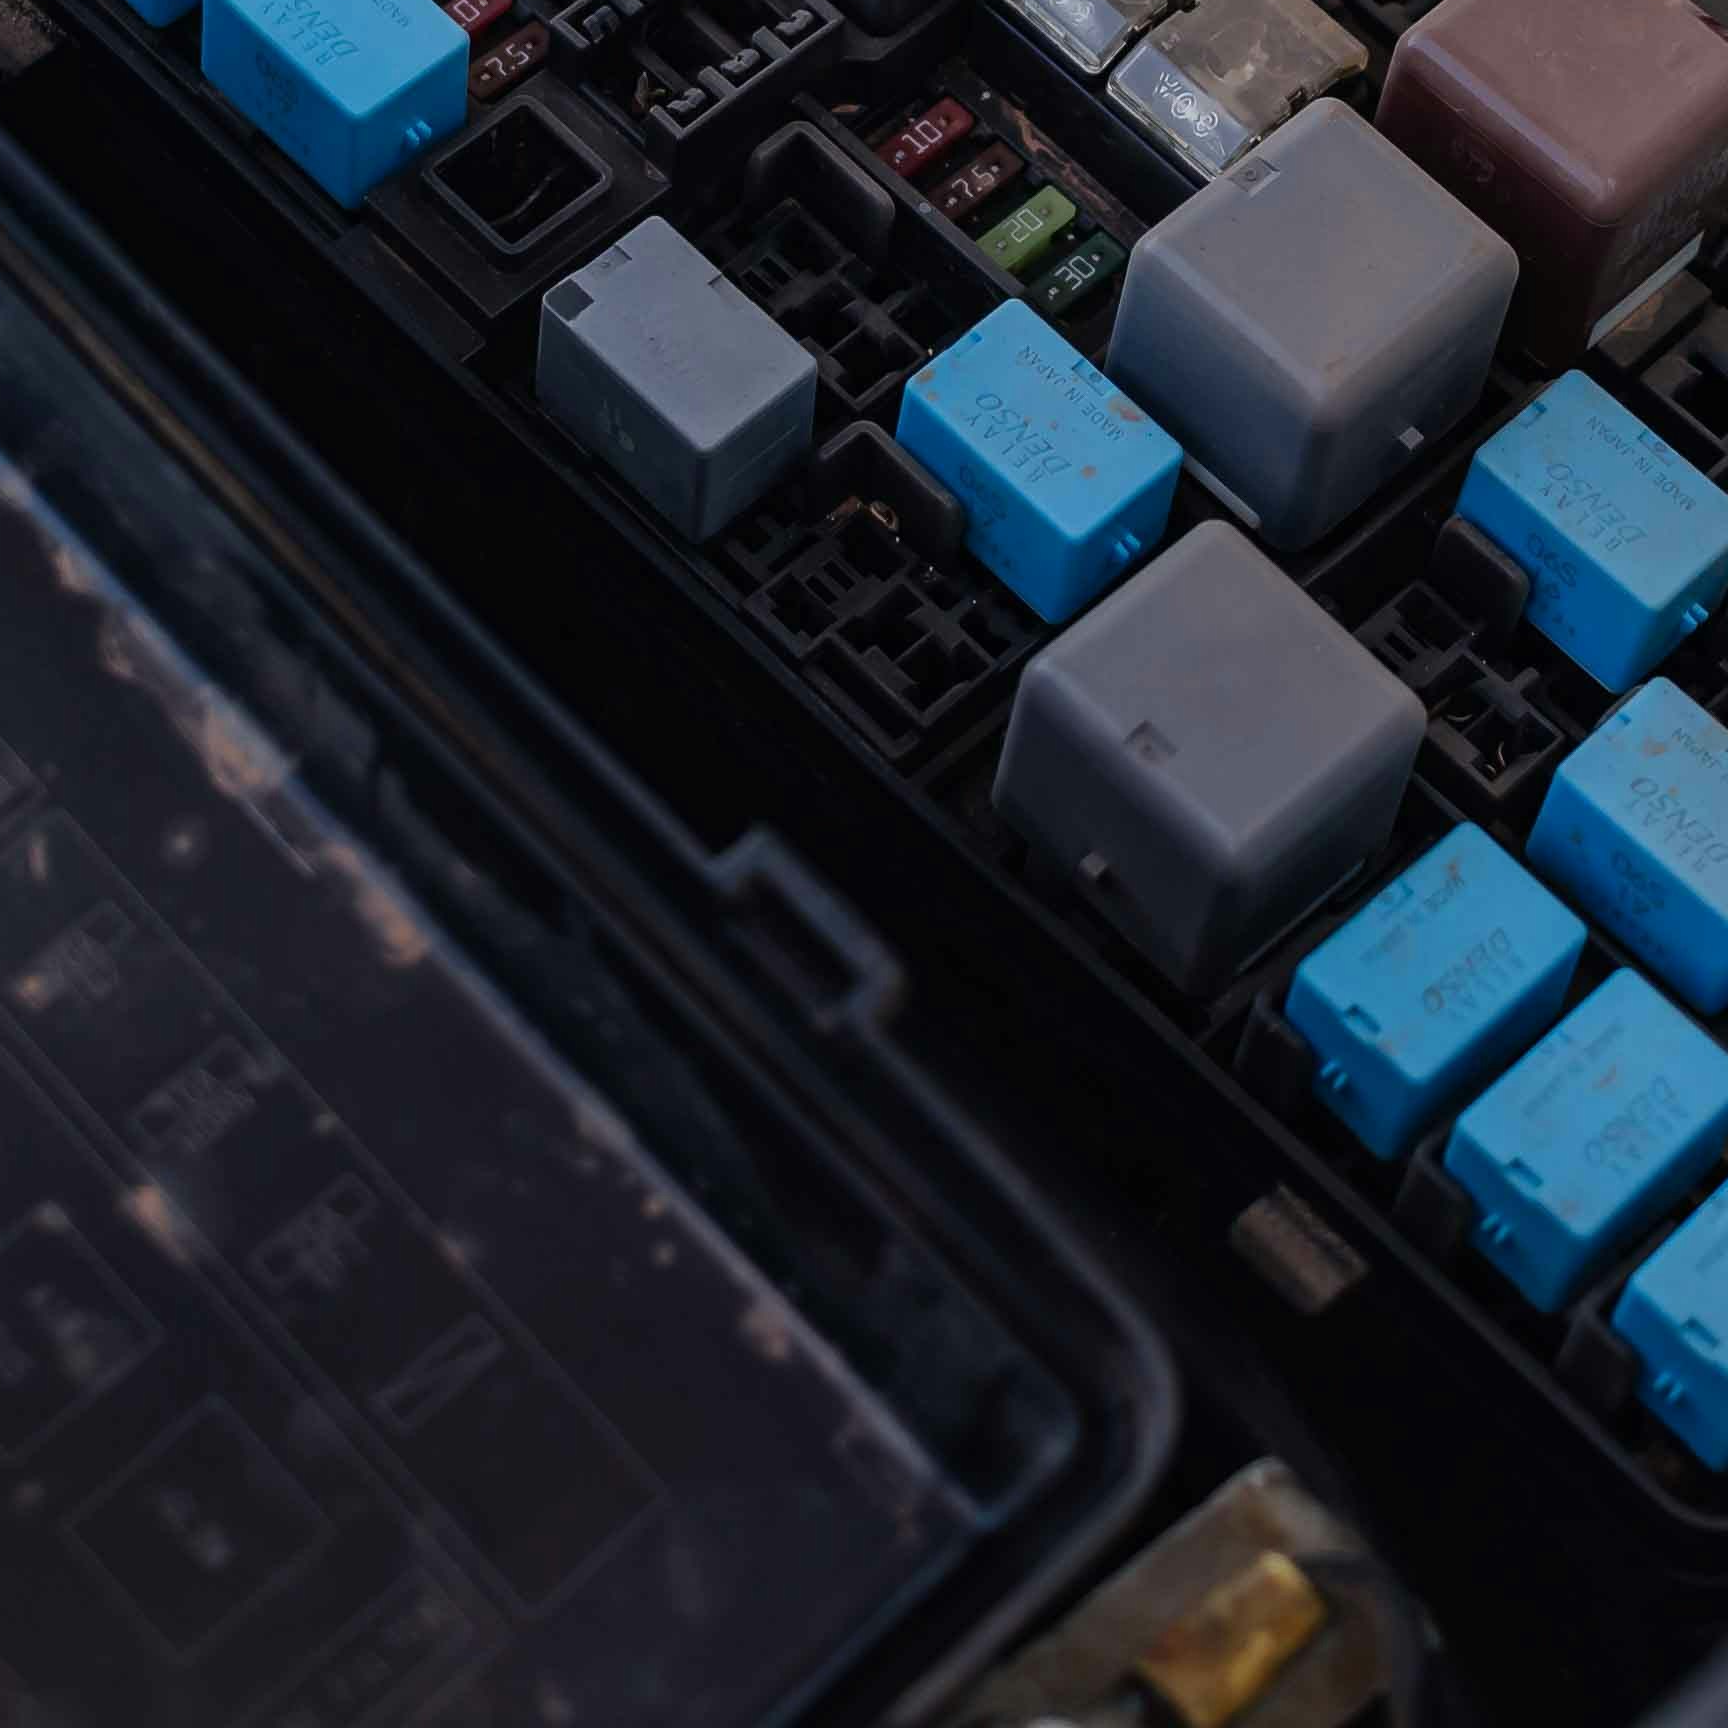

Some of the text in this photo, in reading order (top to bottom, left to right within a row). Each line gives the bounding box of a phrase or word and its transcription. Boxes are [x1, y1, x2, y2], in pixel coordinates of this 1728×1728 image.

[264, 1, 335, 65] RELAY
[484, 43, 529, 76] 7.5
[902, 120, 943, 154] 10
[951, 165, 995, 198] 7.5
[1003, 208, 1043, 243] 20
[1054, 255, 1096, 291] 30
[1018, 345, 1067, 385] JAPAN
[976, 393, 1072, 474] DENSO
[1081, 404, 1125, 441] MADE
[1587, 416, 1633, 456] JAPAN
[964, 414, 1045, 483] RELAY
[1546, 463, 1648, 545] DENSO
[1653, 475, 1697, 512] MADE
[1540, 484, 1623, 552] RELAY
